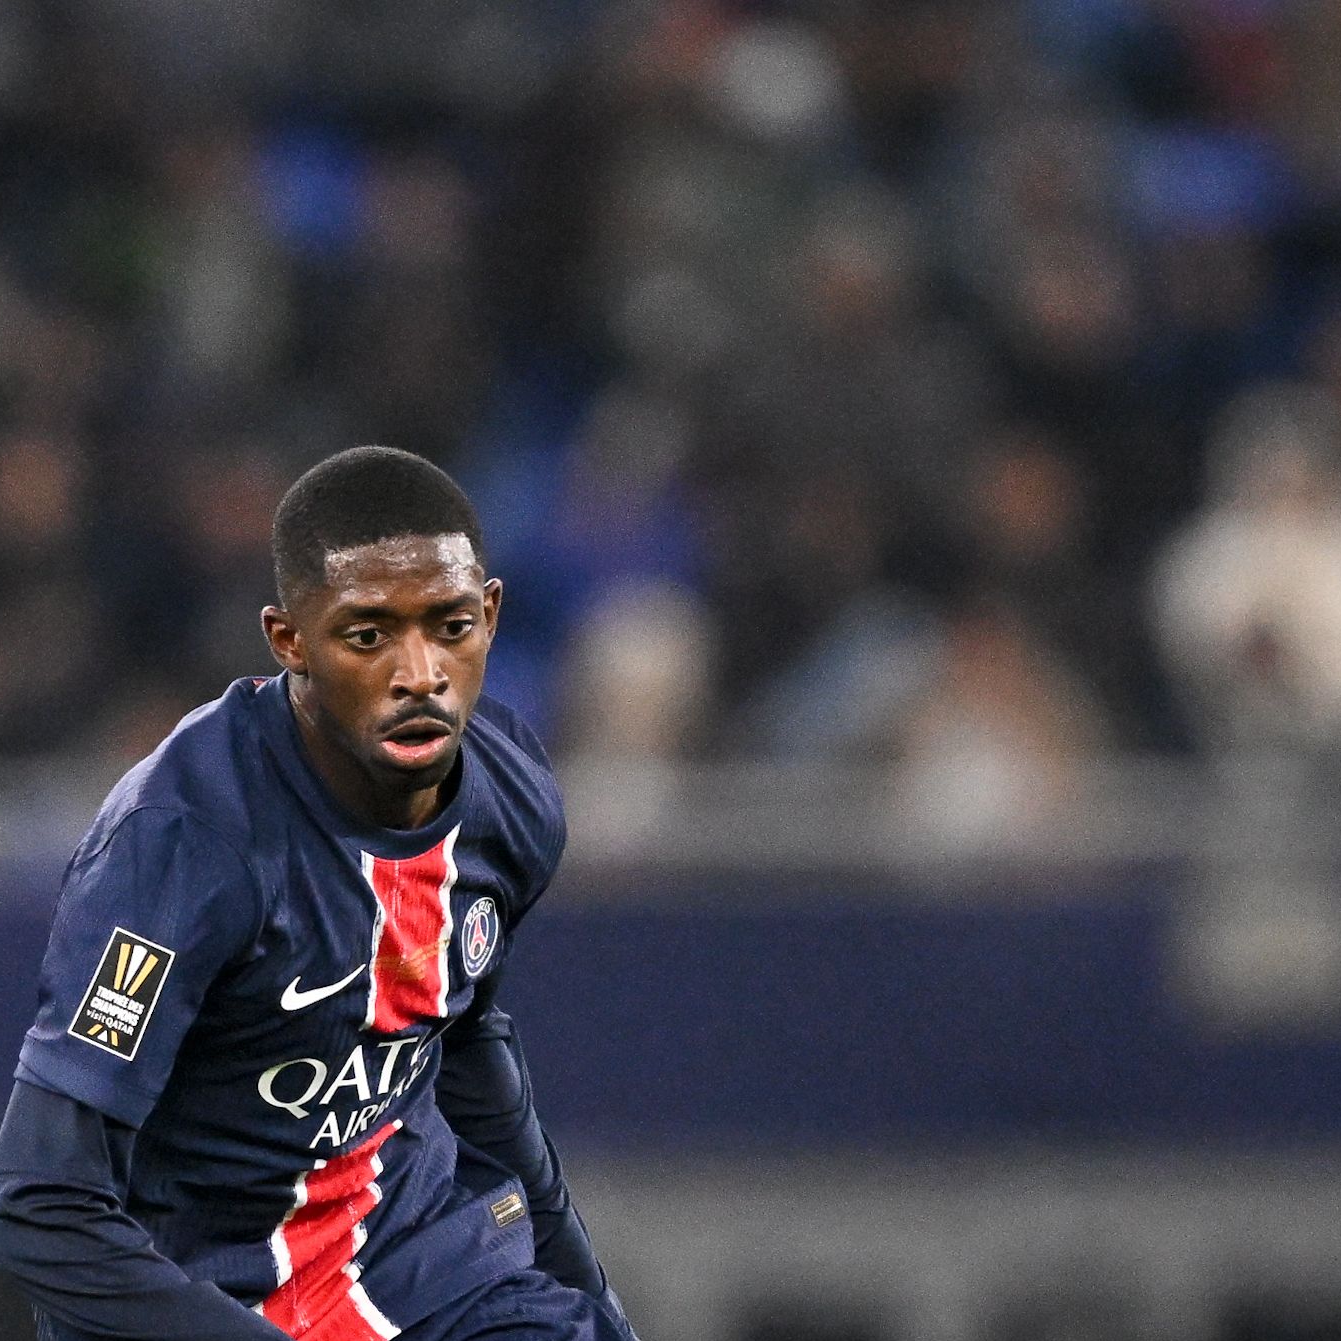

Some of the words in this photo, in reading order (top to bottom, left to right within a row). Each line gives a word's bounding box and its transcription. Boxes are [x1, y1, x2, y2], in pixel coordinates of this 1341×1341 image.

[466, 901, 492, 925] PARIS
[90, 996, 139, 1026] CHAMPIONS
[127, 999, 145, 1015] DES
[257, 1028, 433, 1119] QAT
